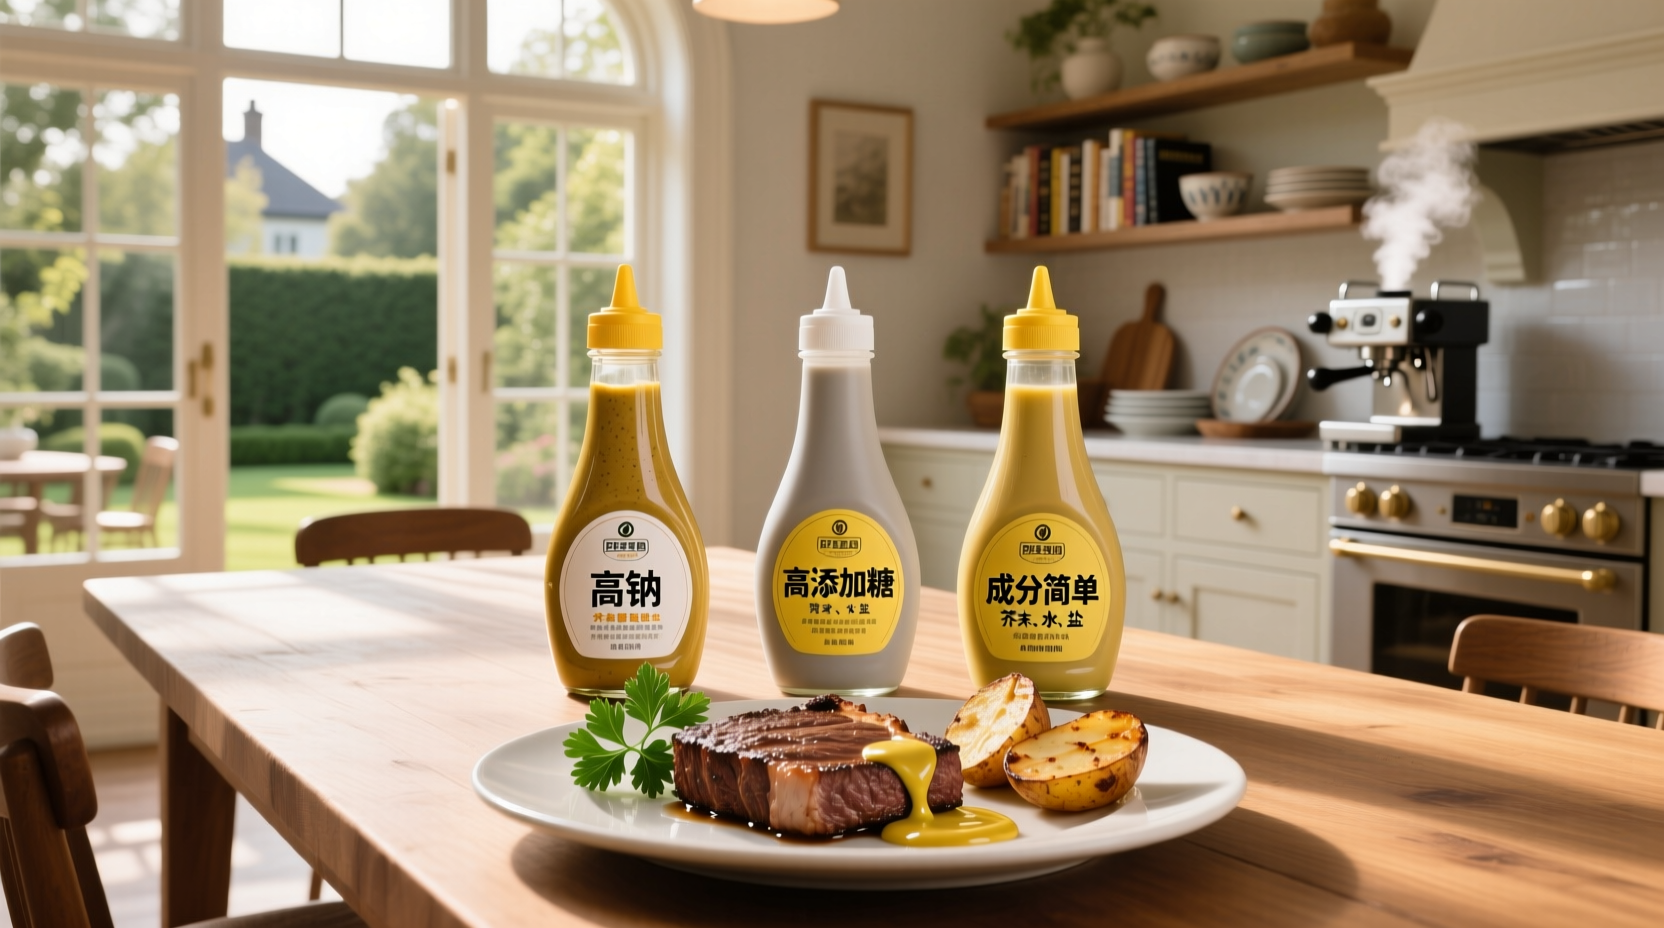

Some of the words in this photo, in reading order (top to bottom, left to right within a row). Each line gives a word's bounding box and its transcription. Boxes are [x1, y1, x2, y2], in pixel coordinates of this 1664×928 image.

[591, 569, 661, 607] 高钠
[783, 566, 895, 598] 高添加糖
[986, 573, 1099, 605] 成分简单
[1000, 609, 1084, 628] 芥末、水、盐
